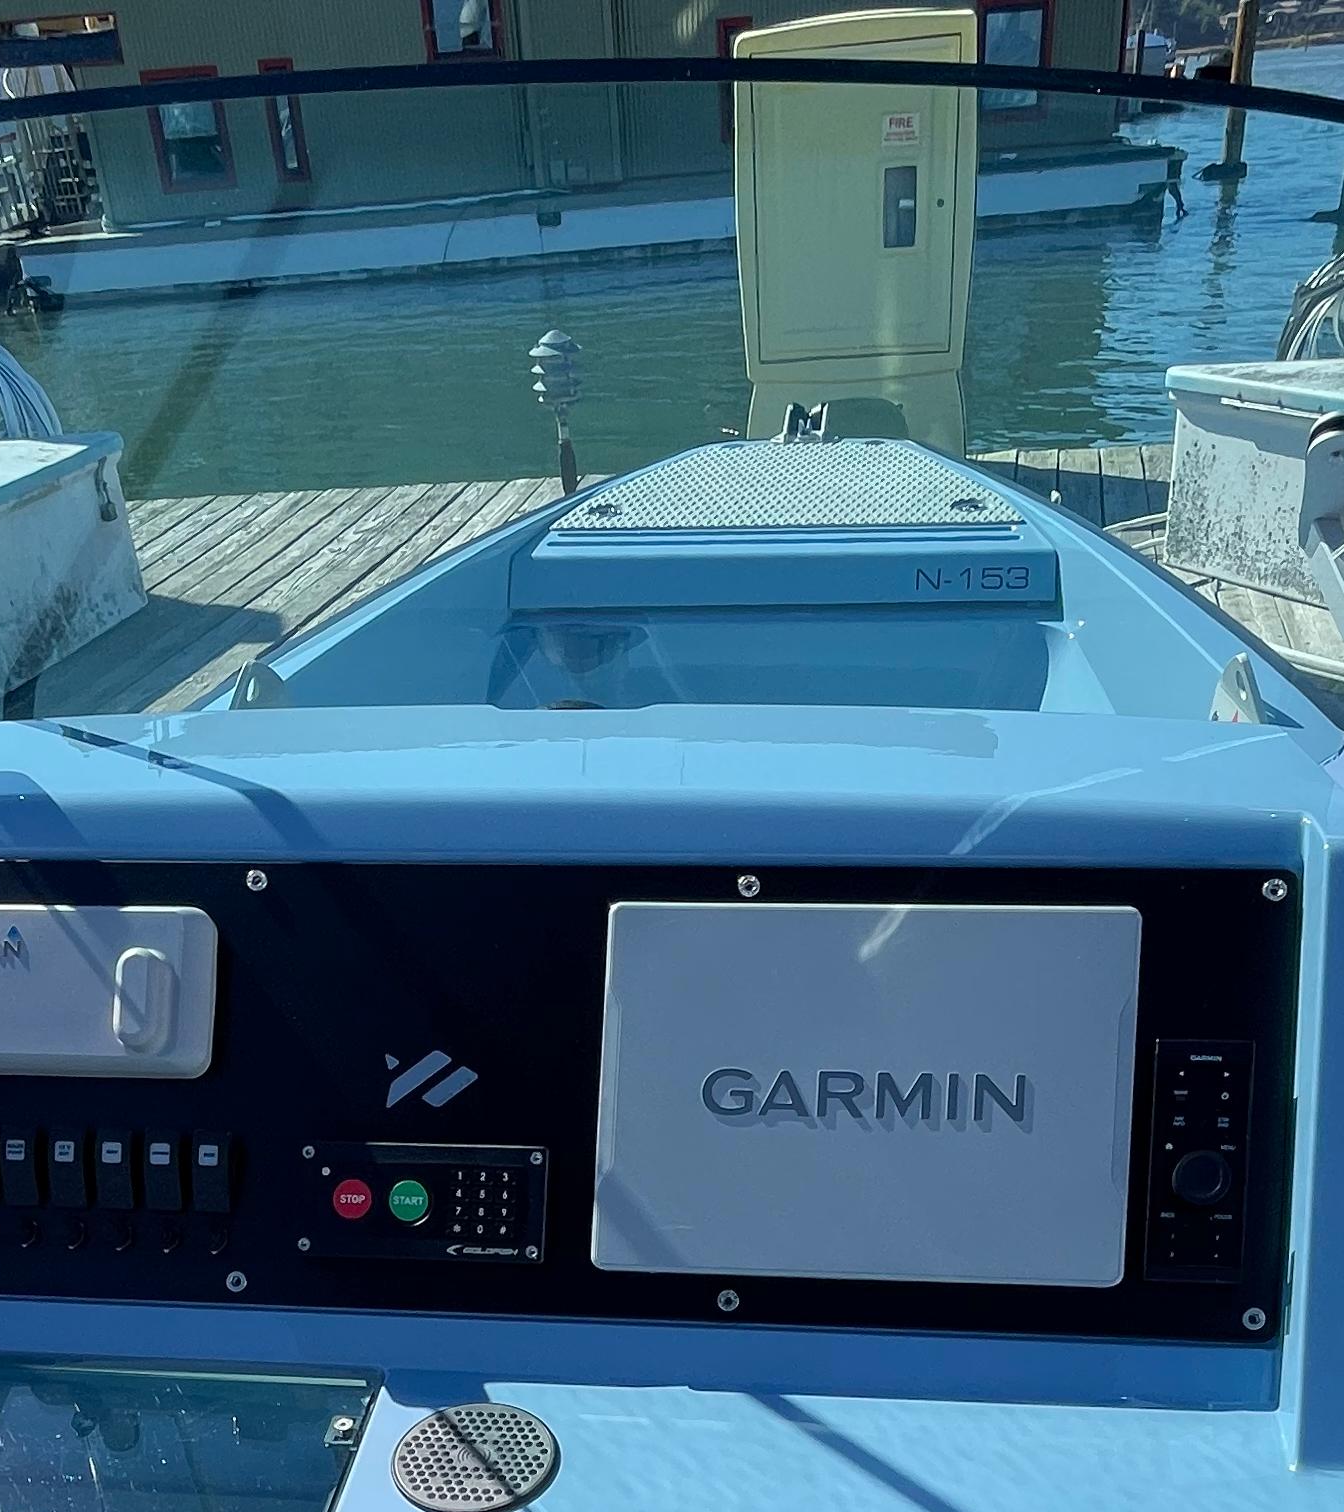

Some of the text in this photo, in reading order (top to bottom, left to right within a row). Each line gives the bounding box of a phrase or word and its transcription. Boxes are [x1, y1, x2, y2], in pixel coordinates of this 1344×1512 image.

[888, 116, 914, 129] FIRE
[915, 566, 1031, 591] N-153
[701, 1066, 1027, 1123] GARMIN
[479, 1171, 487, 1182] 2
[502, 1171, 509, 1182] 3
[339, 1193, 366, 1205] STOP
[479, 1189, 486, 1199] 5
[392, 1195, 425, 1206] START
[478, 1207, 485, 1217] 8
